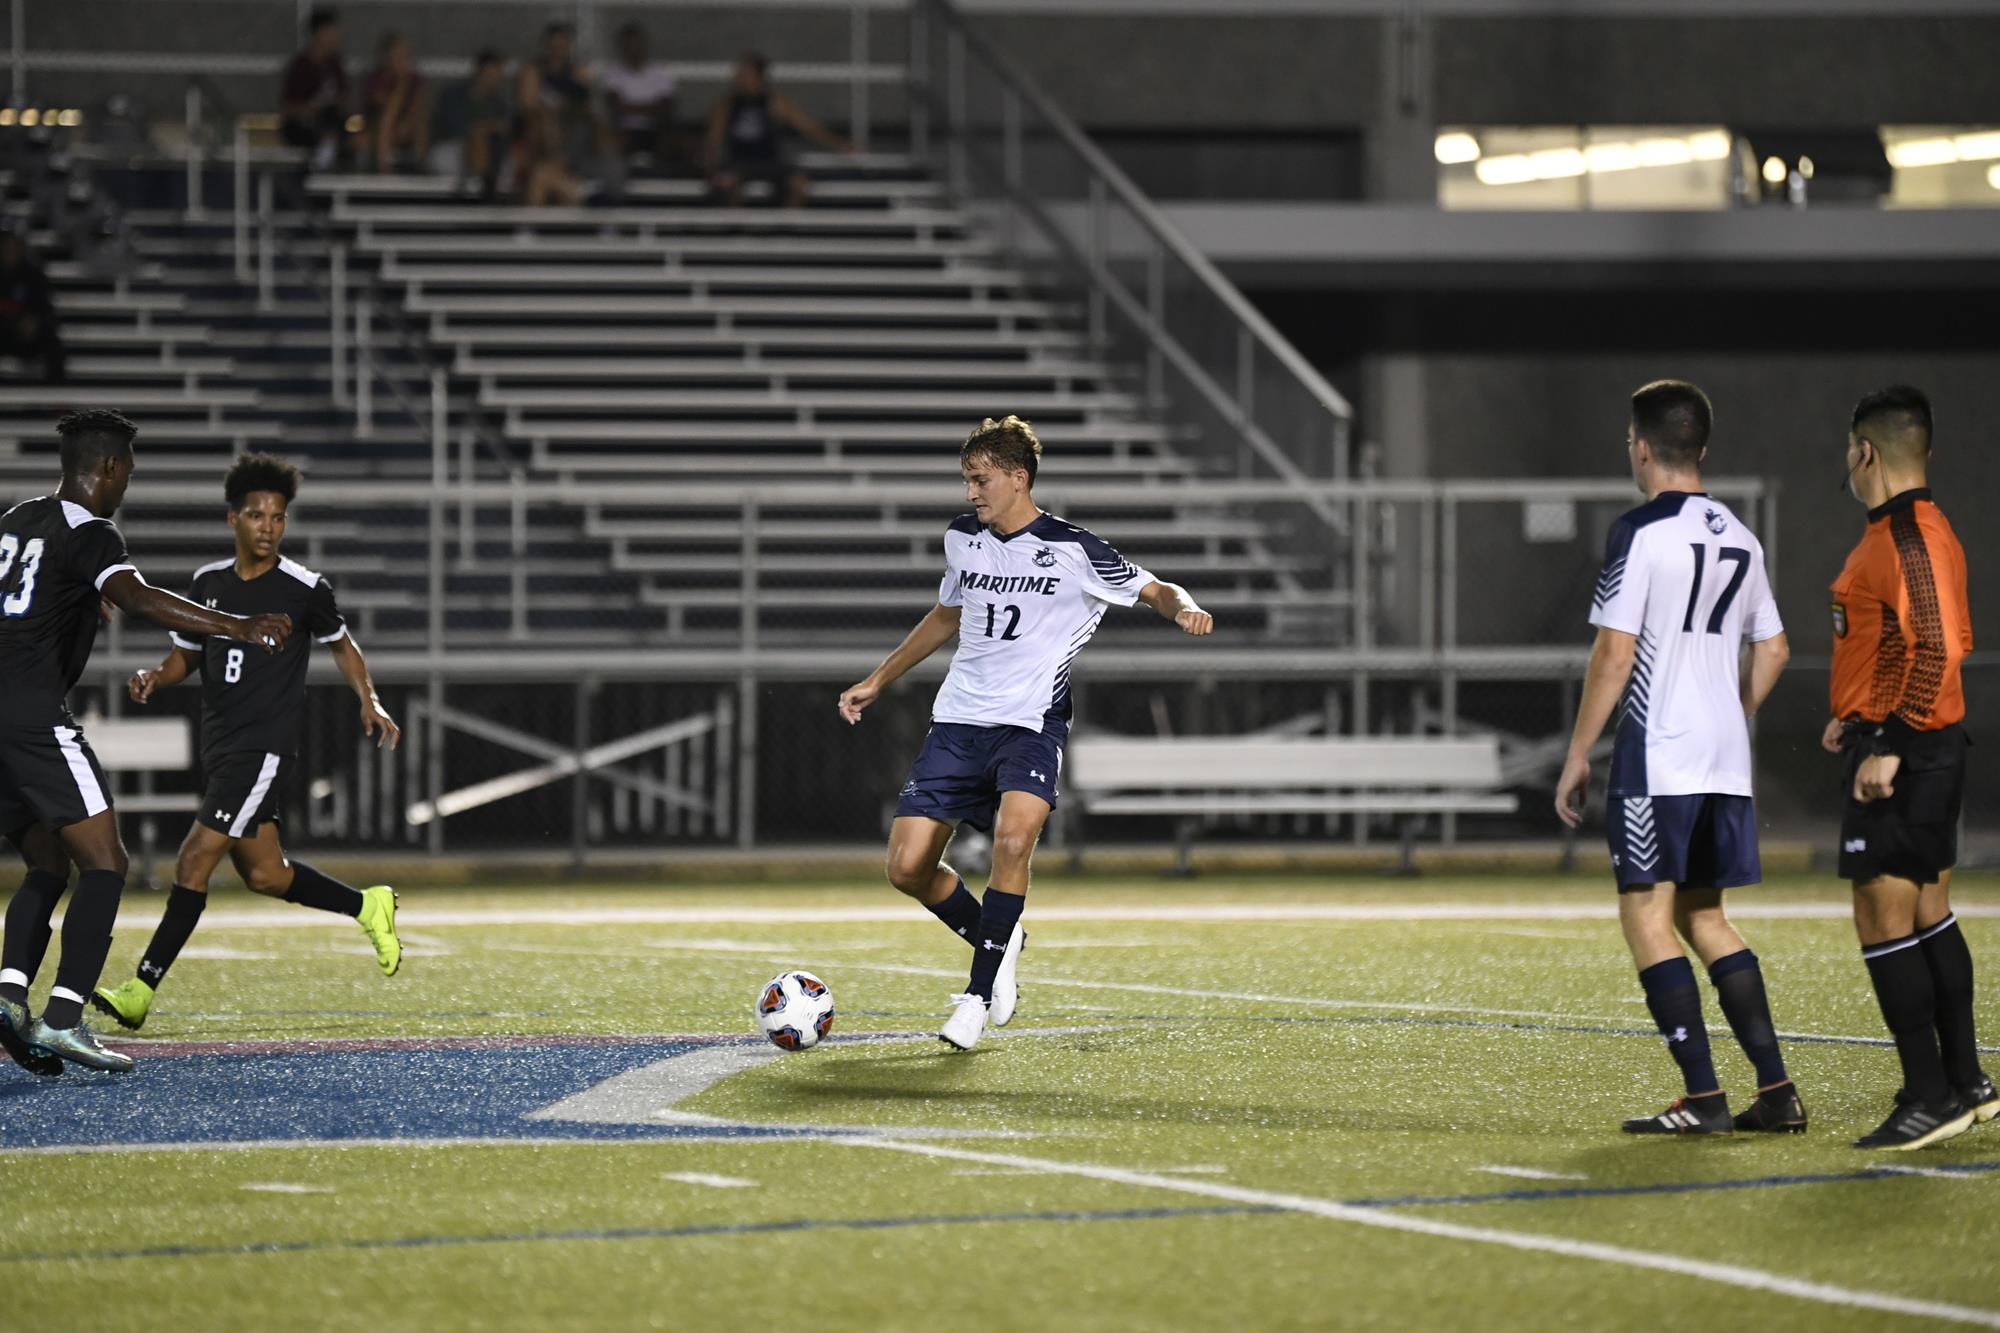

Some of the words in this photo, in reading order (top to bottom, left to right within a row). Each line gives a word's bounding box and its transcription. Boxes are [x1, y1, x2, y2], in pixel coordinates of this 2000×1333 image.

[960, 570, 1060, 596] MARITIME
[1682, 543, 1751, 635] 17
[984, 602, 1022, 641] 12
[225, 649, 244, 684] 8
